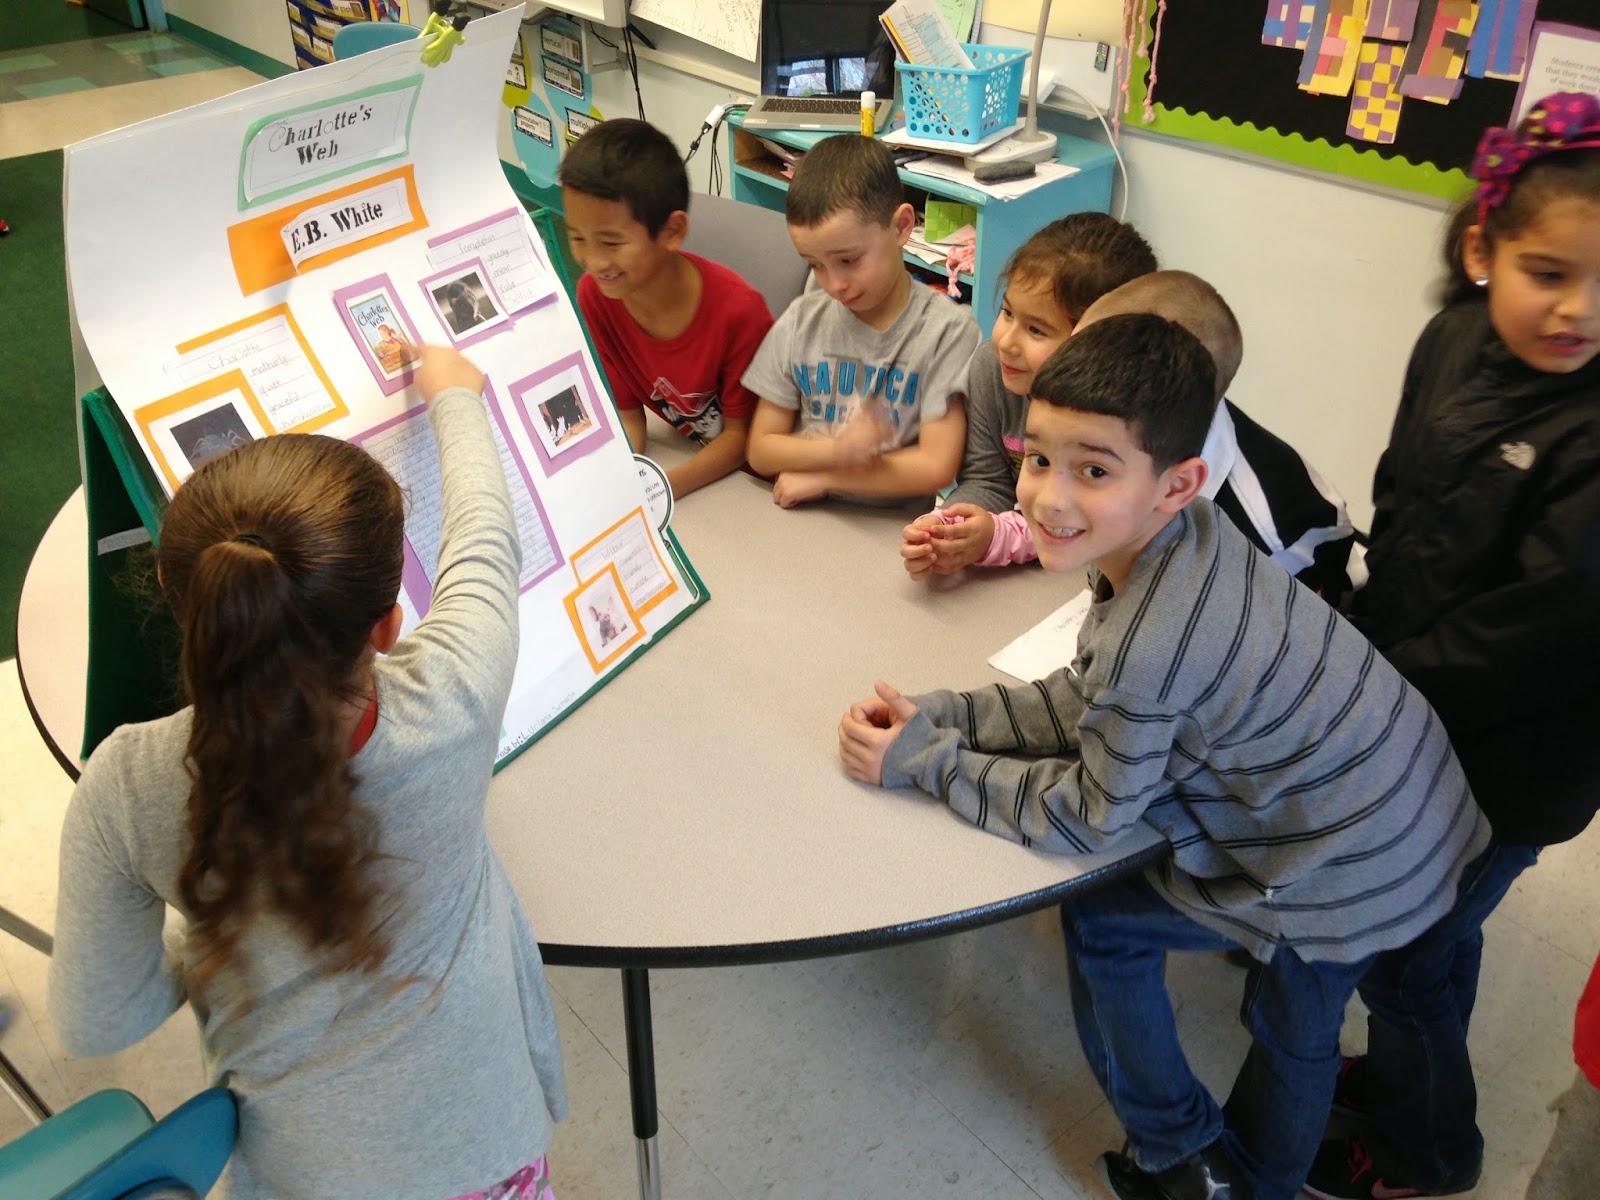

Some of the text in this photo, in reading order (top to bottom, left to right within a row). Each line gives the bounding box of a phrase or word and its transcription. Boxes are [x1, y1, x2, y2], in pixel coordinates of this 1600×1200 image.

[1551, 57, 1584, 70] Students
[269, 105, 373, 153] Charlotte's
[291, 220, 328, 254] E.B.
[330, 202, 383, 232] White
[357, 304, 389, 327] Charlotte's
[368, 313, 386, 329] Web
[207, 342, 264, 370] Charlotte
[251, 354, 289, 376] motherly
[793, 360, 920, 407] NAUTICA
[269, 392, 300, 416] graceful
